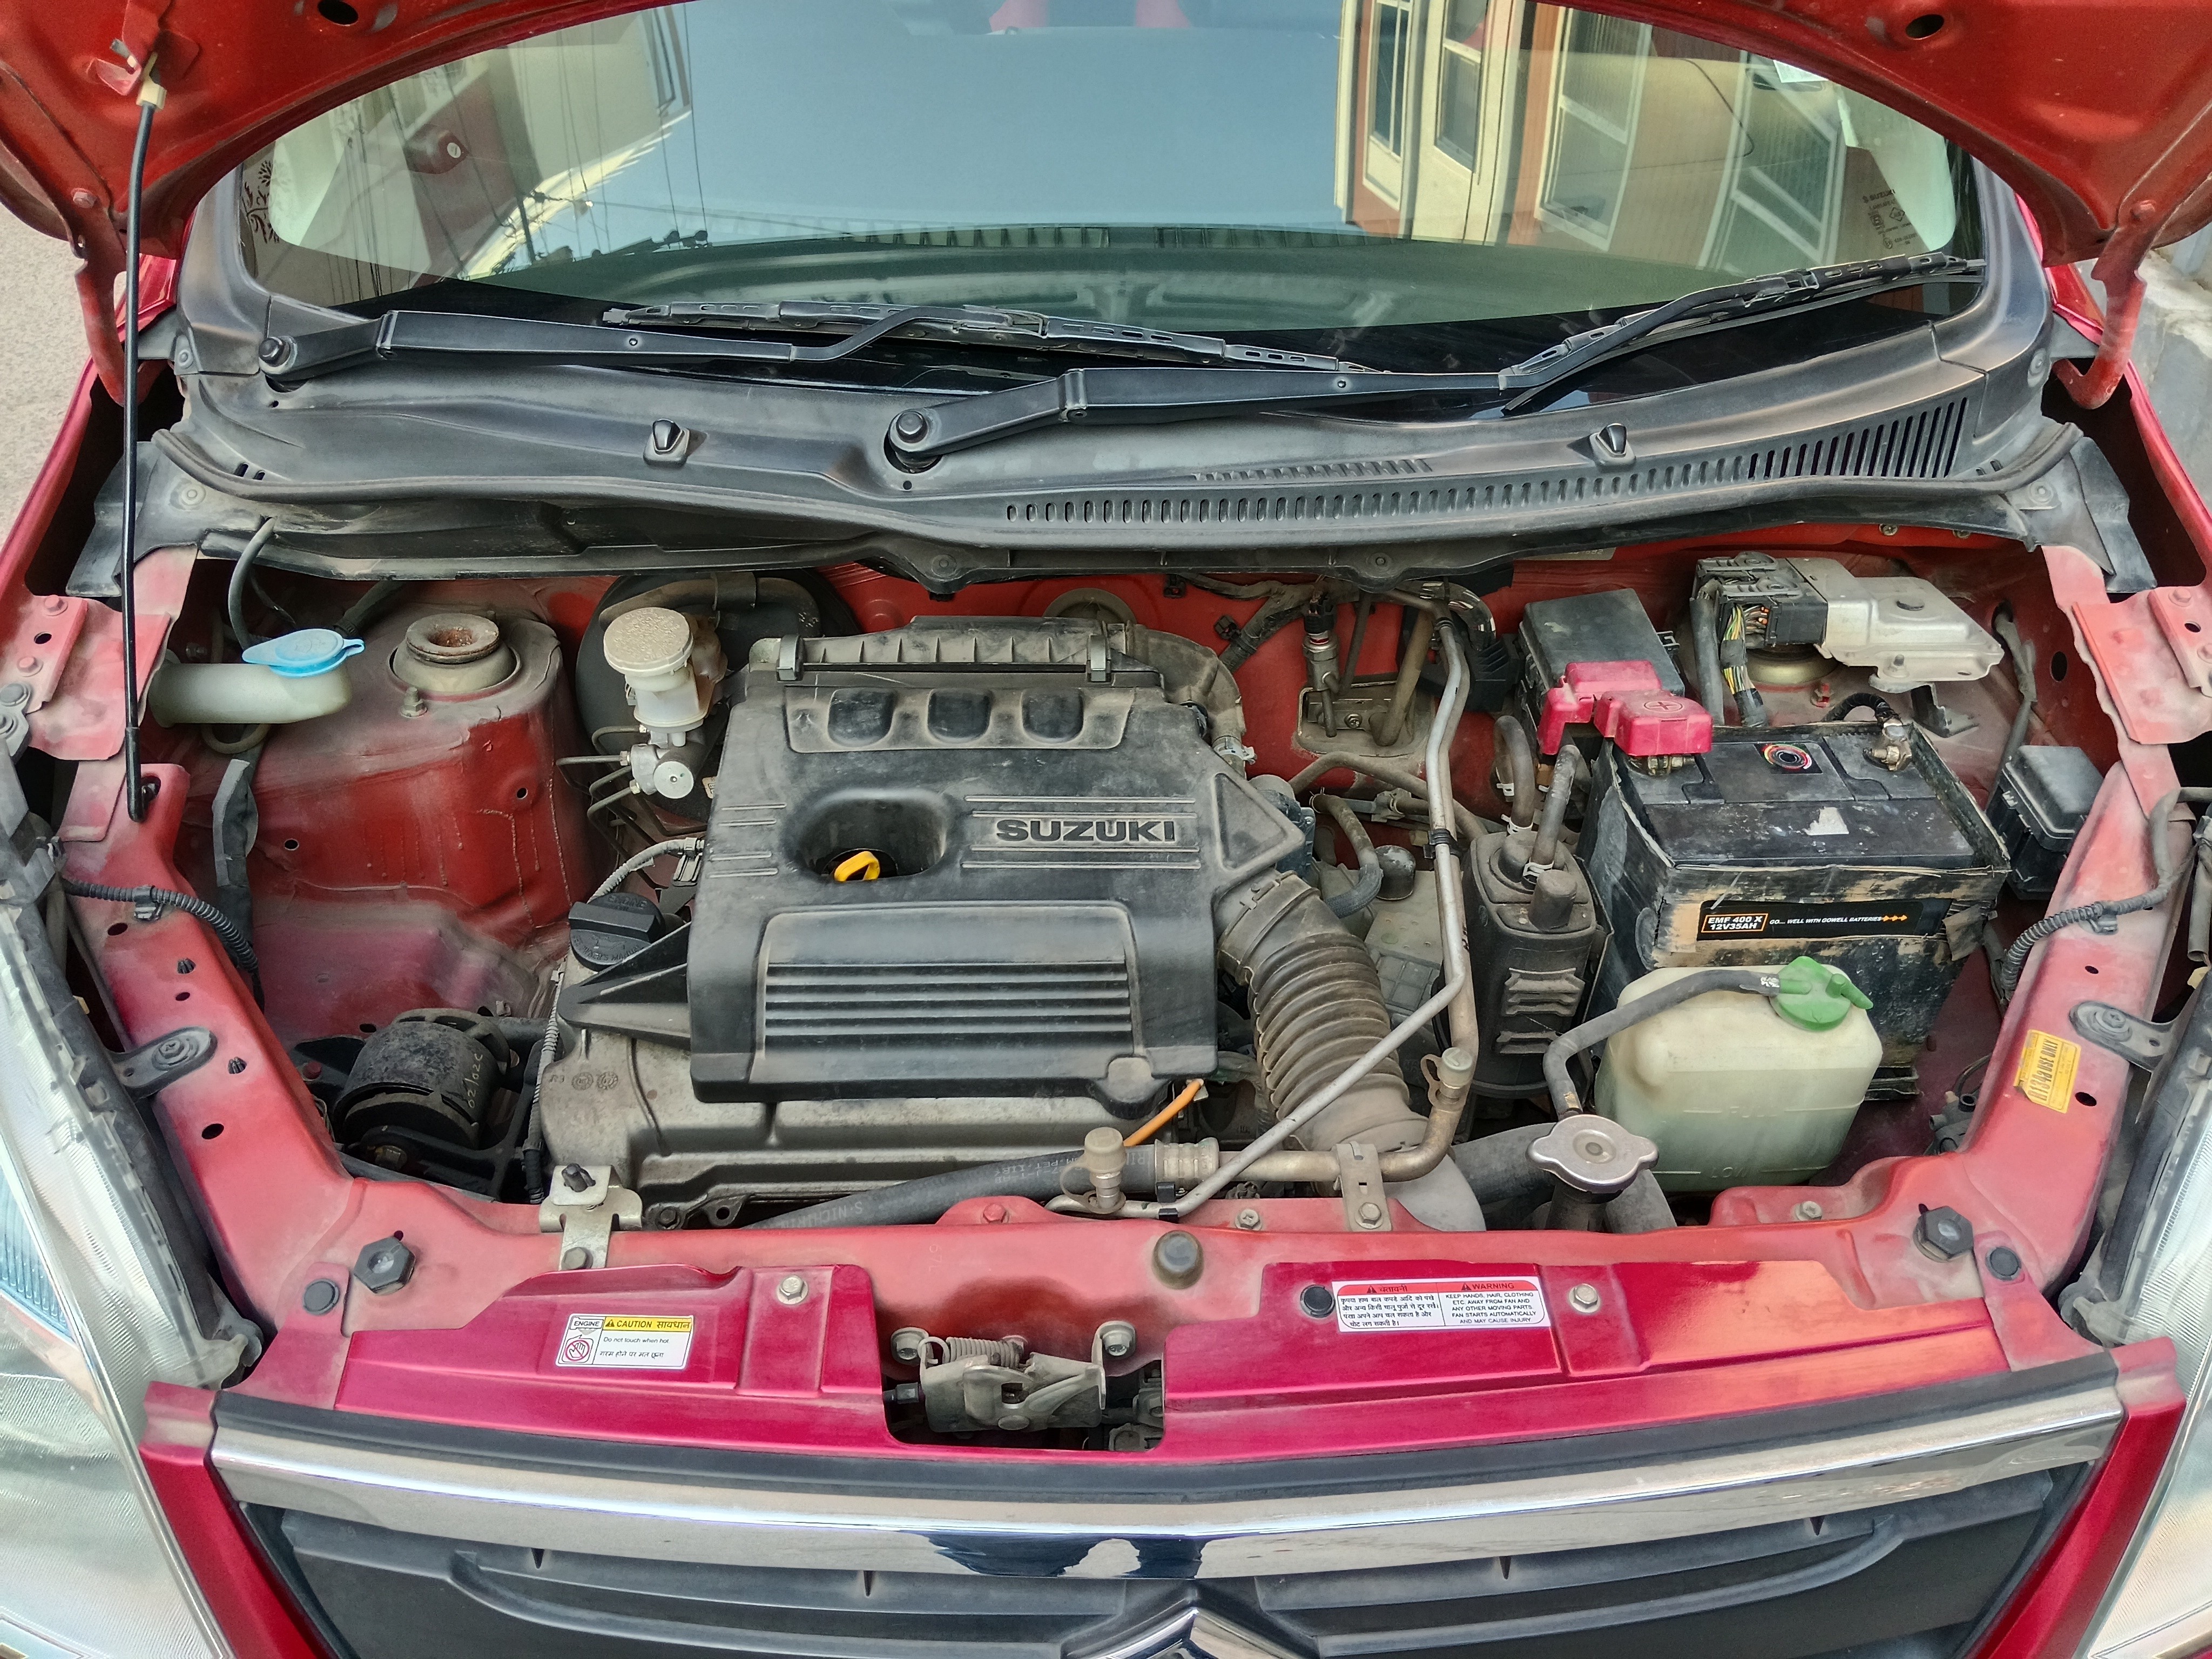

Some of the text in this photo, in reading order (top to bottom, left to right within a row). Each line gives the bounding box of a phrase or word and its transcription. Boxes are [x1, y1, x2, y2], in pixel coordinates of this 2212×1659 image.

[996, 819, 1175, 842] SUZUKI
[2040, 1038, 2059, 1058] ONLY
[2037, 1056, 2054, 1072] USE
[656, 1321, 690, 1329] सावधान
